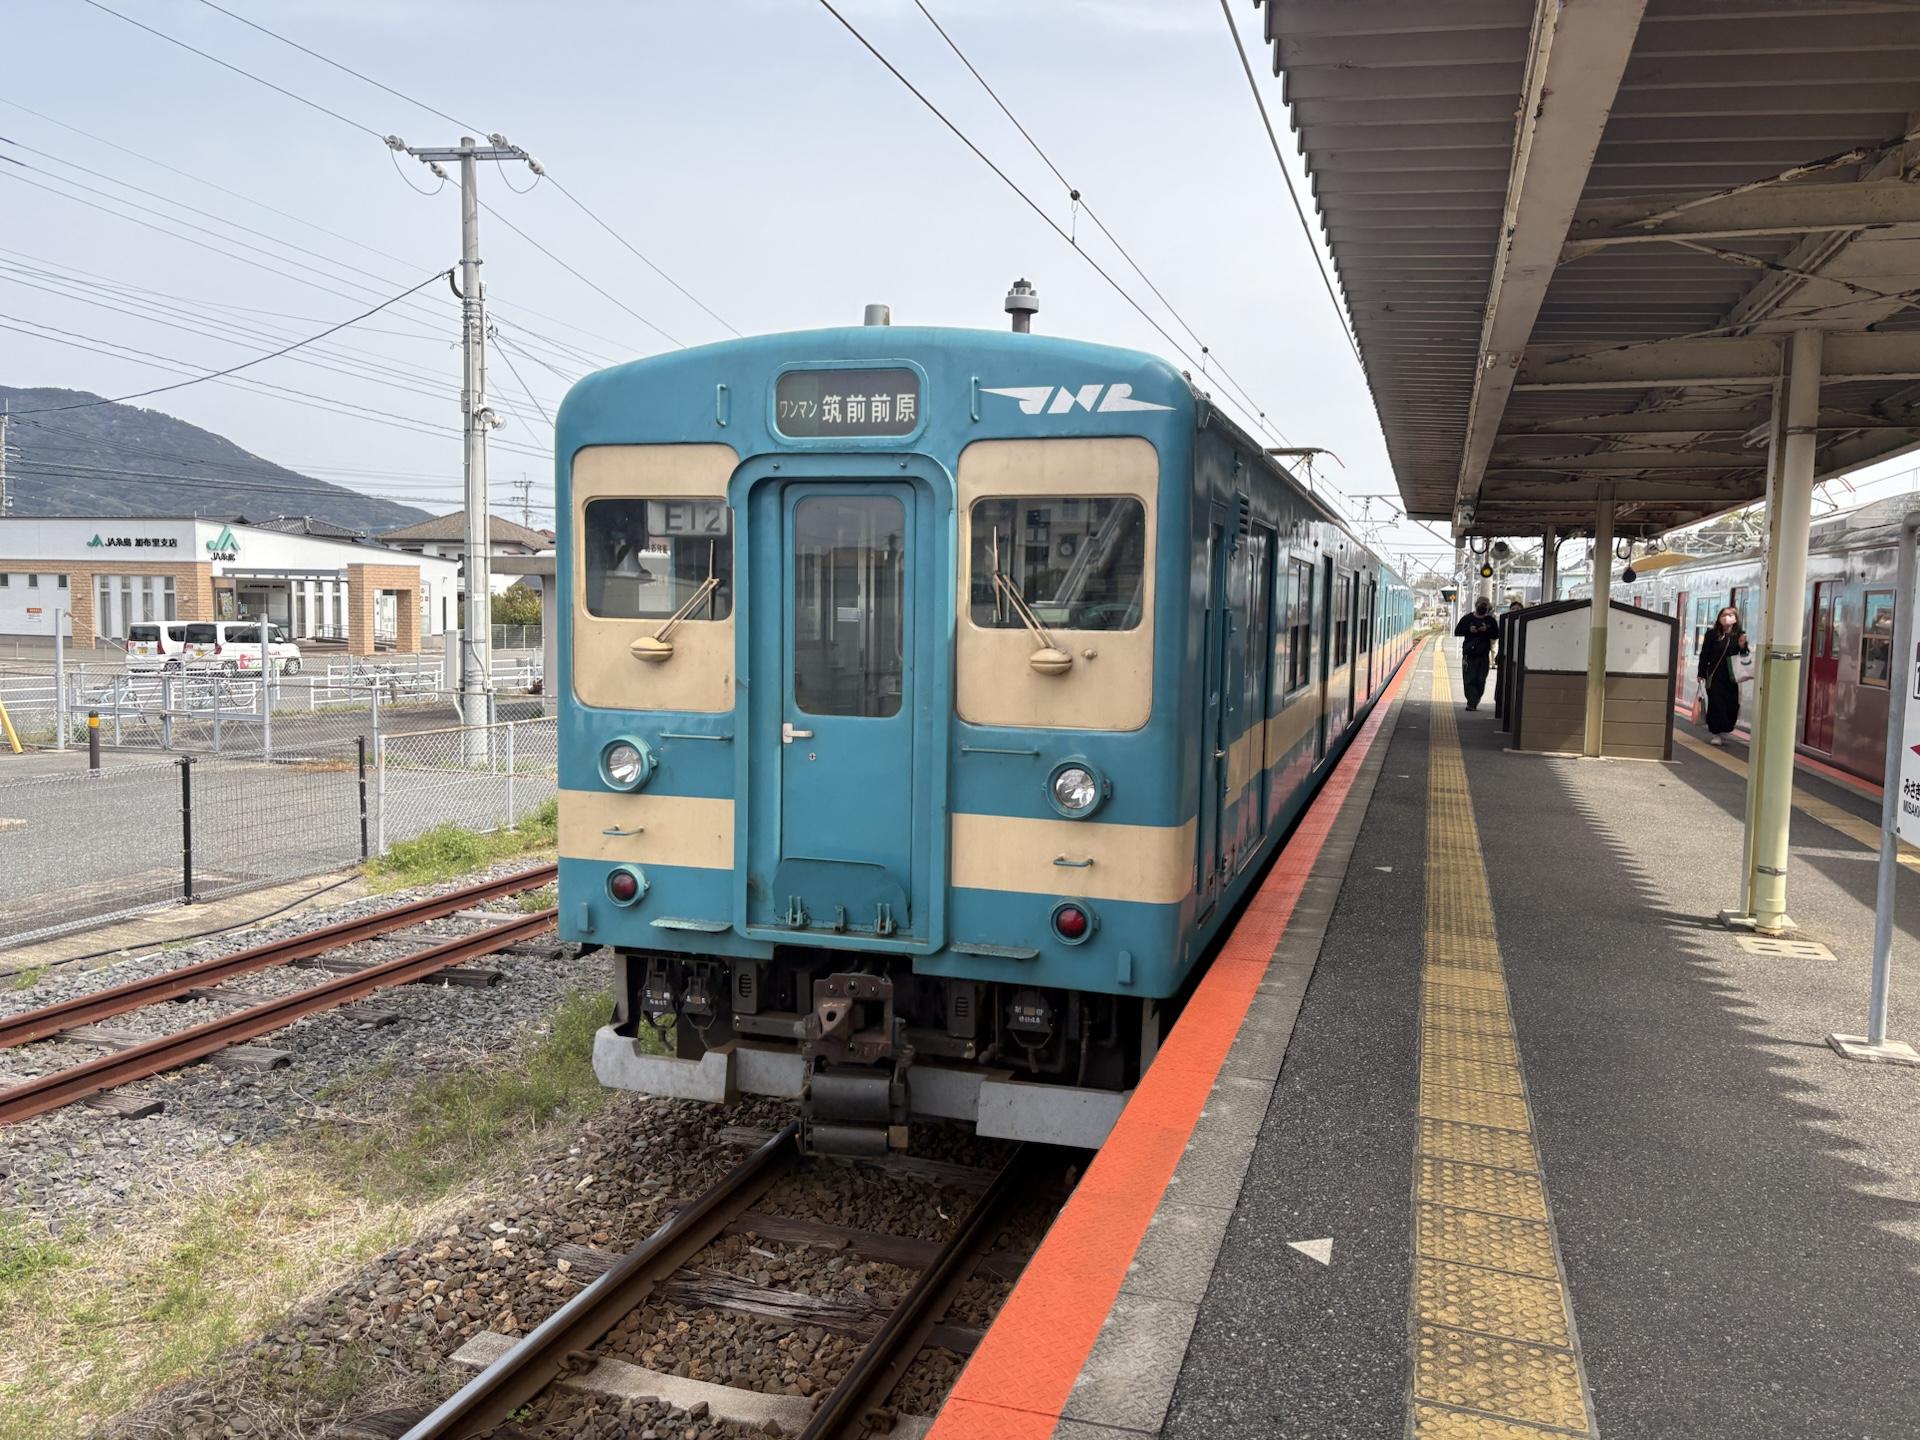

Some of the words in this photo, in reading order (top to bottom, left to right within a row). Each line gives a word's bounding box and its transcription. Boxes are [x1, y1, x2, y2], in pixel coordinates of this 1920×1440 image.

[780, 399, 818, 419] ワンマン
[822, 393, 916, 424] 筑前前原
[977, 383, 1177, 415] JNR
[666, 504, 722, 532] E12
